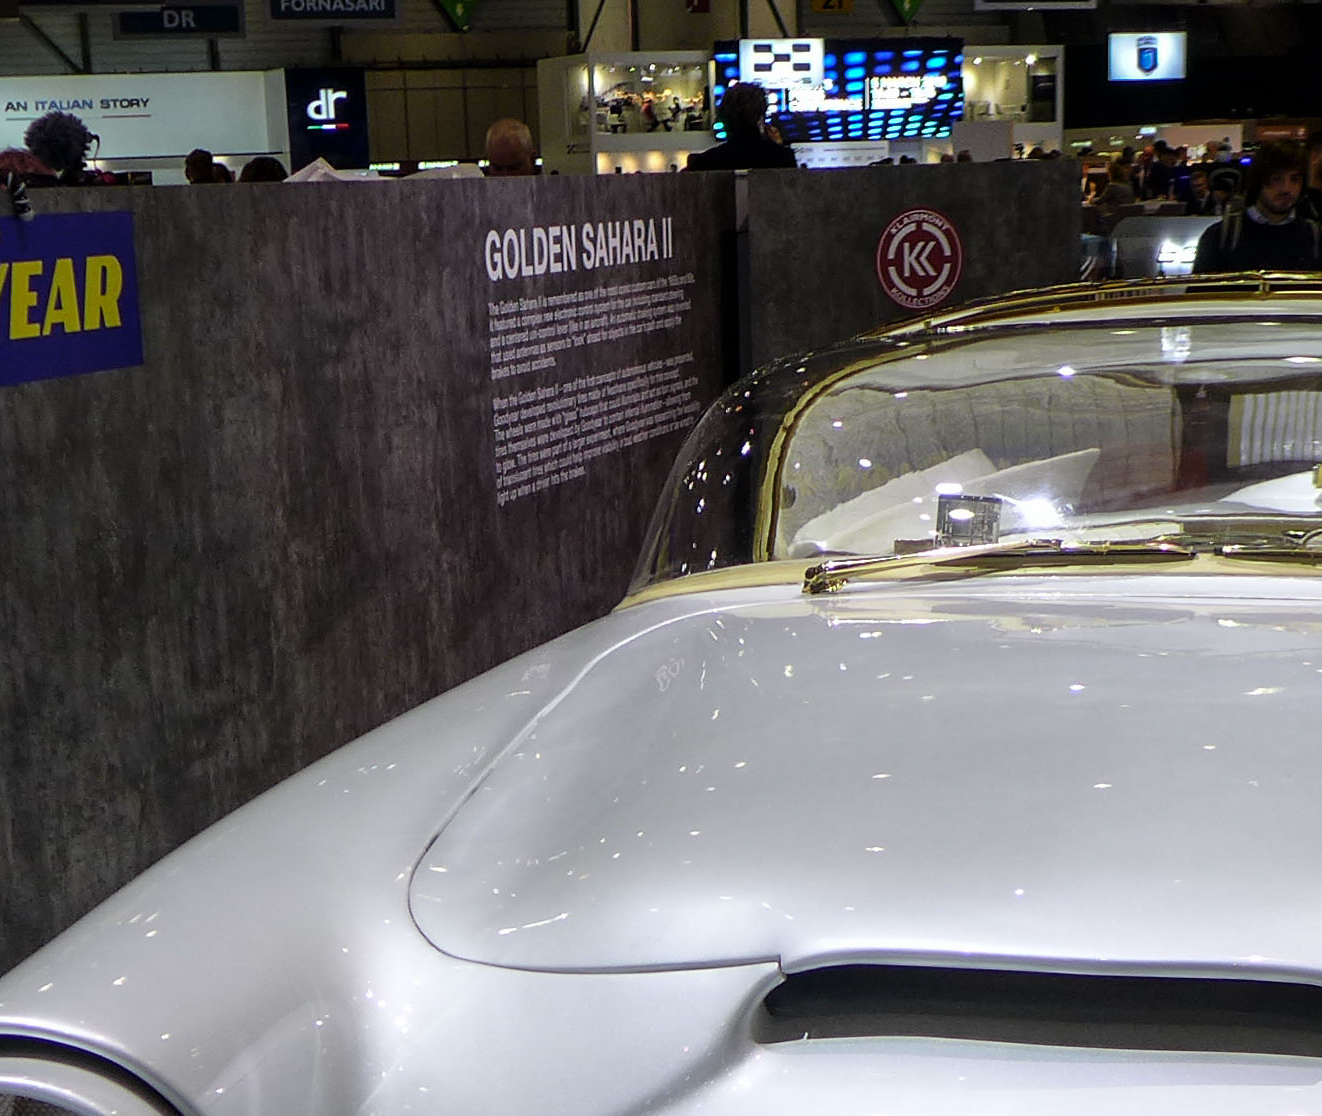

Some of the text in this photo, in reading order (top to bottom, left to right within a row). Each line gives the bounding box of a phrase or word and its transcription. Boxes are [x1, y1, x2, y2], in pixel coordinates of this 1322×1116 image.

[163, 9, 197, 28] DR
[5, 98, 150, 112] AN ITALIAN STORY
[306, 88, 348, 120] dr
[485, 224, 577, 282] GOLDEN
[582, 218, 660, 271] SAHARA
